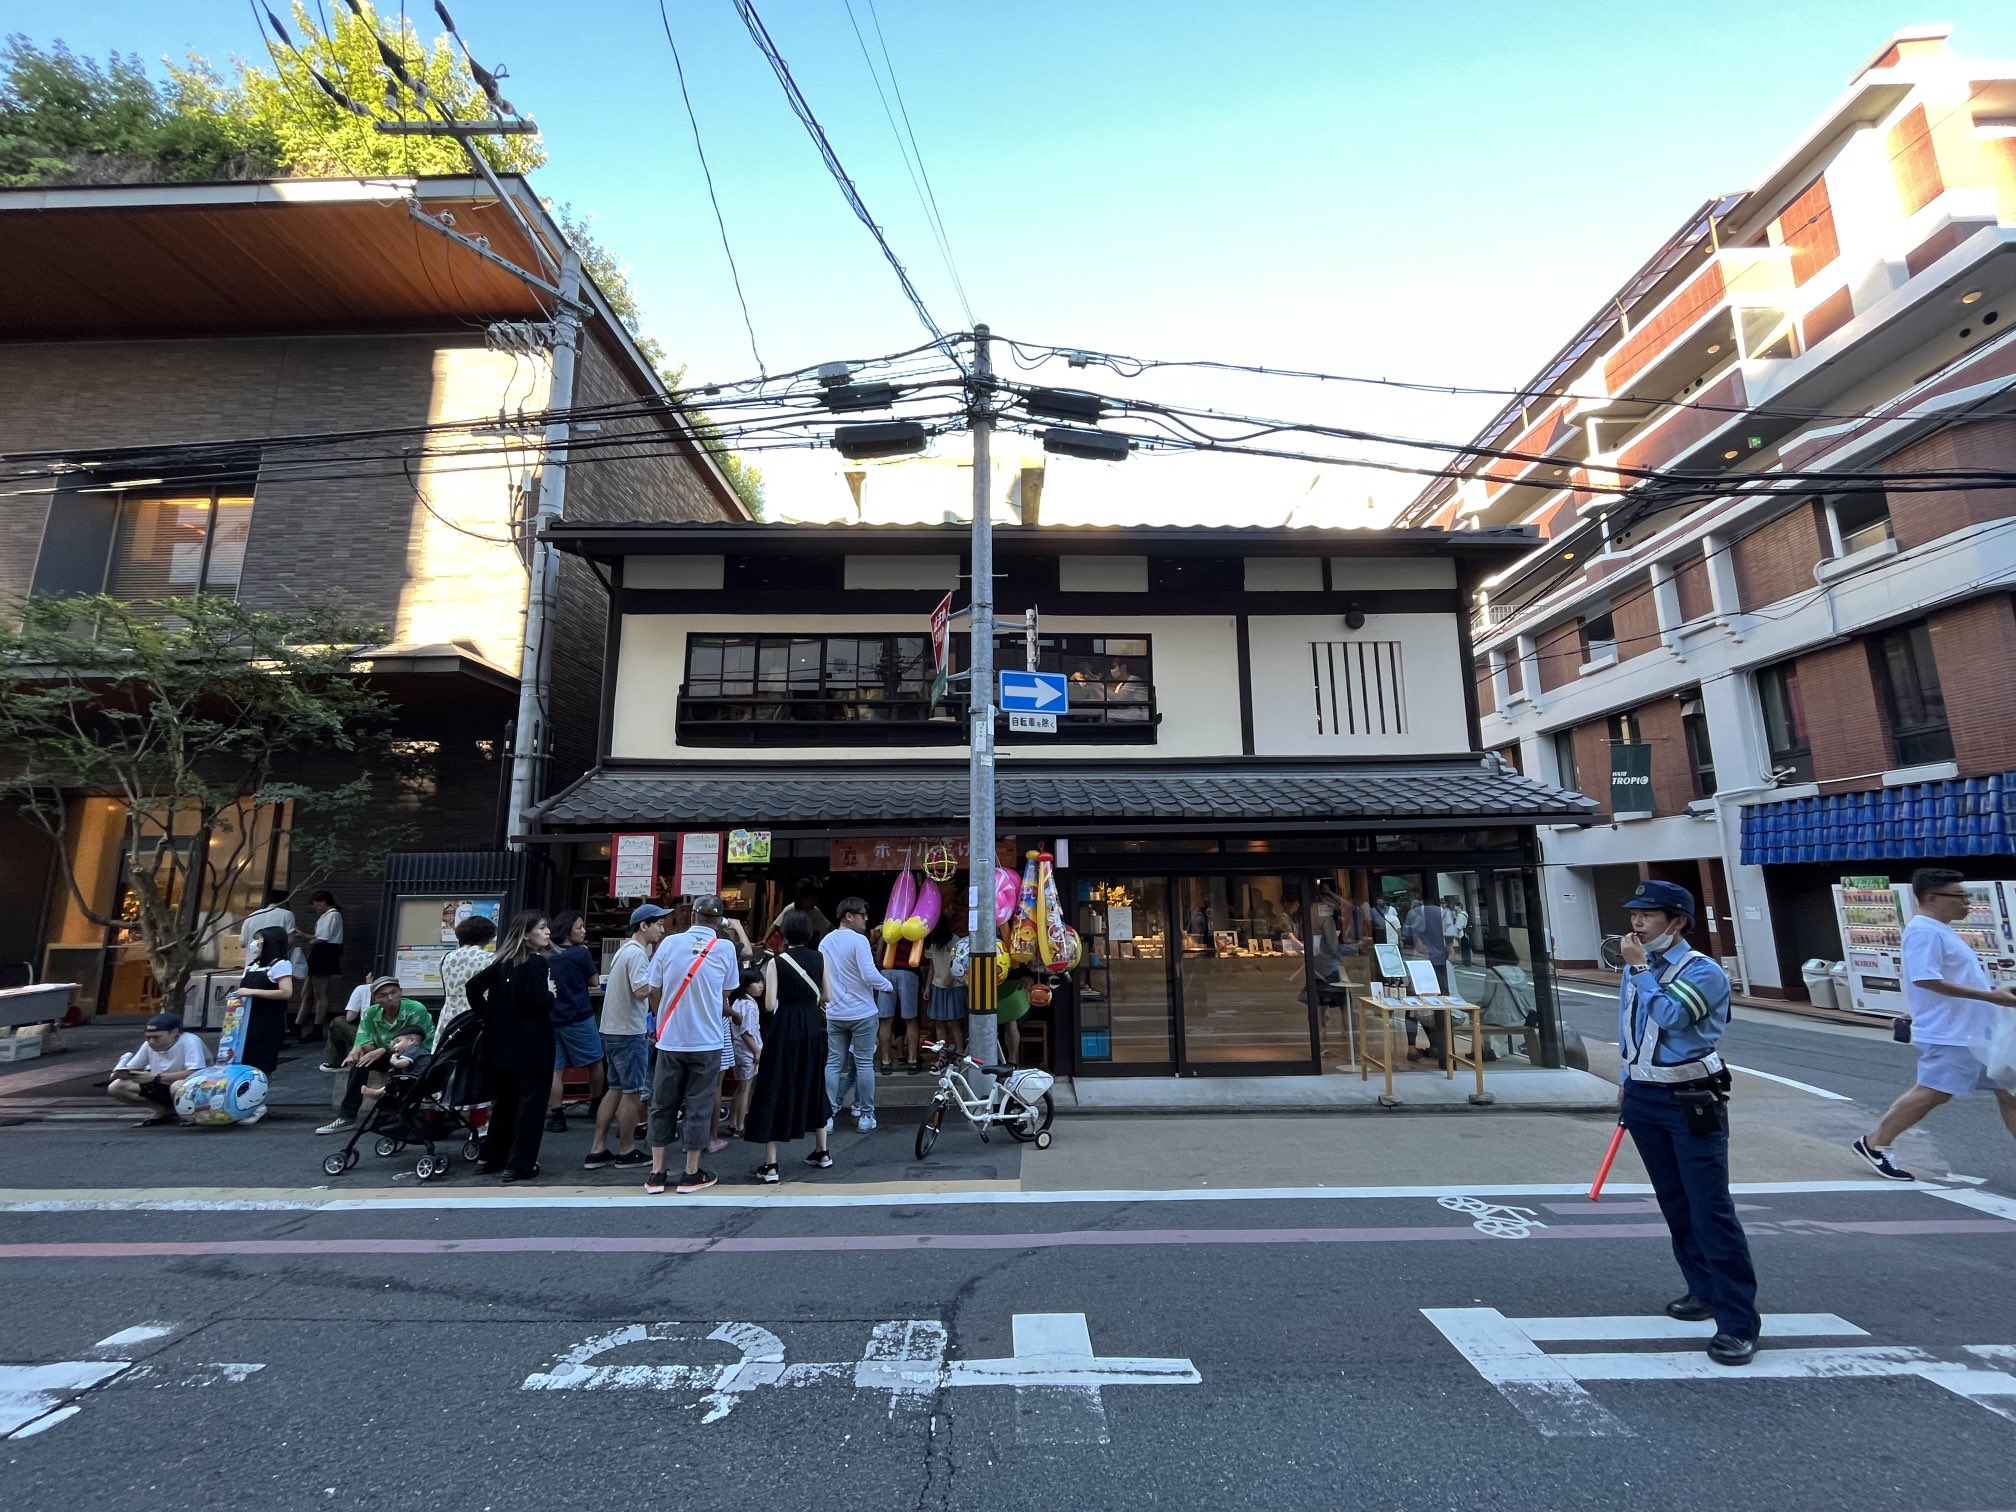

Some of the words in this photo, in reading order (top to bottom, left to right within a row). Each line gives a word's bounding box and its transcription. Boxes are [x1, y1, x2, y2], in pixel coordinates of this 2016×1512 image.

[1012, 717, 1055, 728] 自転車を除く
[1612, 776, 1649, 785] TROPIC
[1854, 960, 1878, 968] KIRIN
